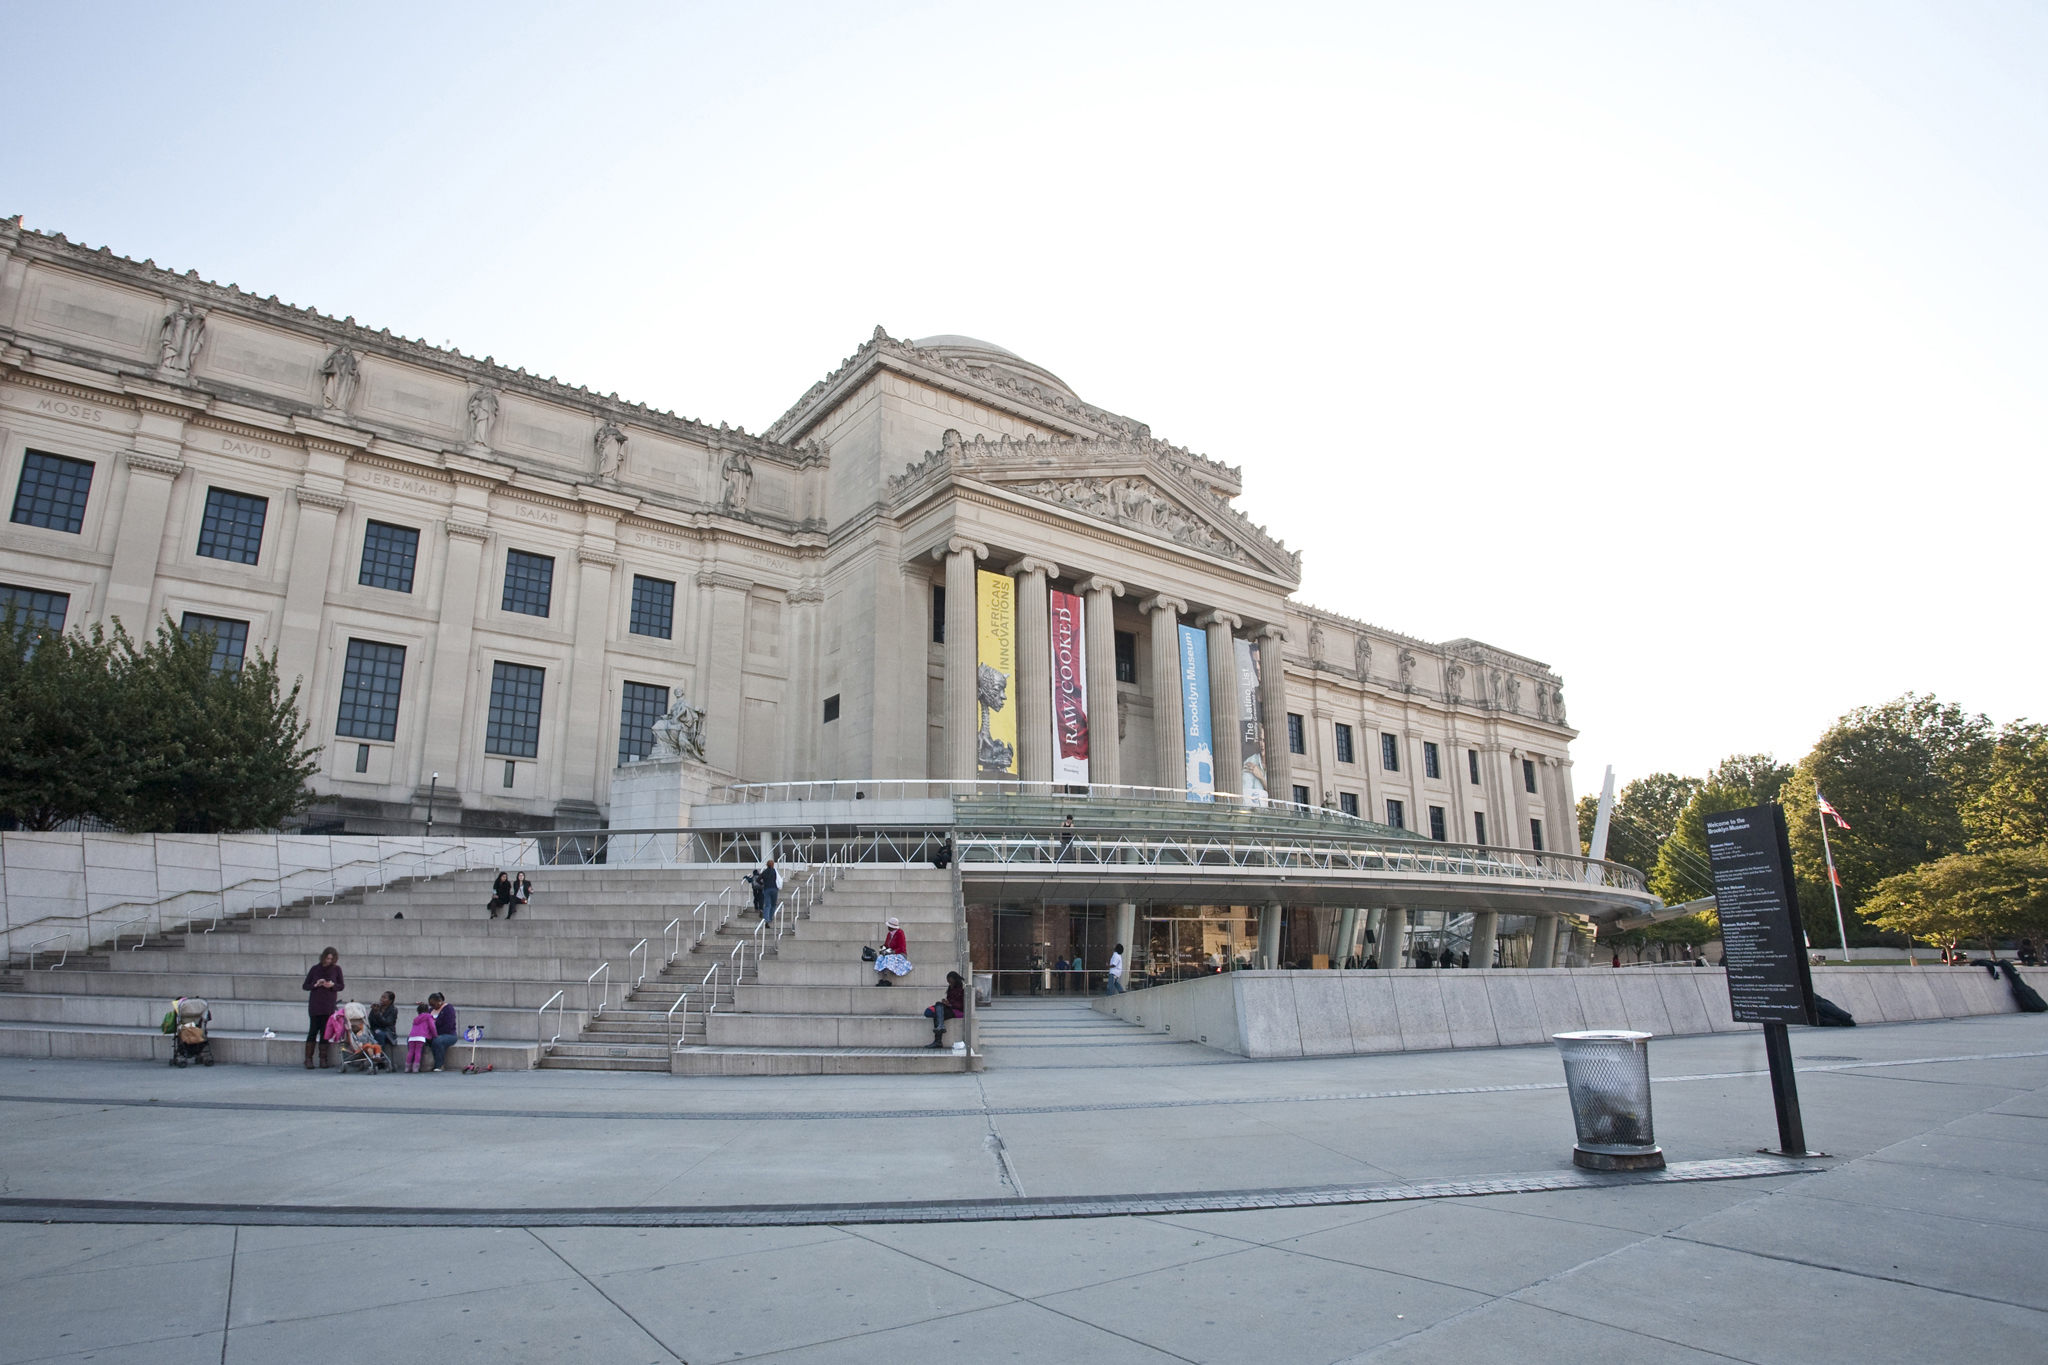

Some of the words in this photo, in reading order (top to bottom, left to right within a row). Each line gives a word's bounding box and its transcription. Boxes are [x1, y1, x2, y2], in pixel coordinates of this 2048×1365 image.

[36, 398, 104, 422] MOSES
[220, 438, 272, 460] DAVID
[361, 469, 438, 498] JEREMIAH
[514, 504, 560, 526] ISAIAH
[990, 580, 1001, 637] AFRICAN
[1000, 582, 1010, 670] INNOVATIONS
[1185, 632, 1196, 681] Museum
[1058, 608, 1078, 746] RAW/COOKED
[1242, 668, 1251, 686] List
[1188, 682, 1200, 738] Brooklyn
[1244, 688, 1253, 720] Latino
[1245, 722, 1254, 742] The
[1707, 820, 1730, 829] Welcome
[1708, 826, 1729, 835] Brooklyn
